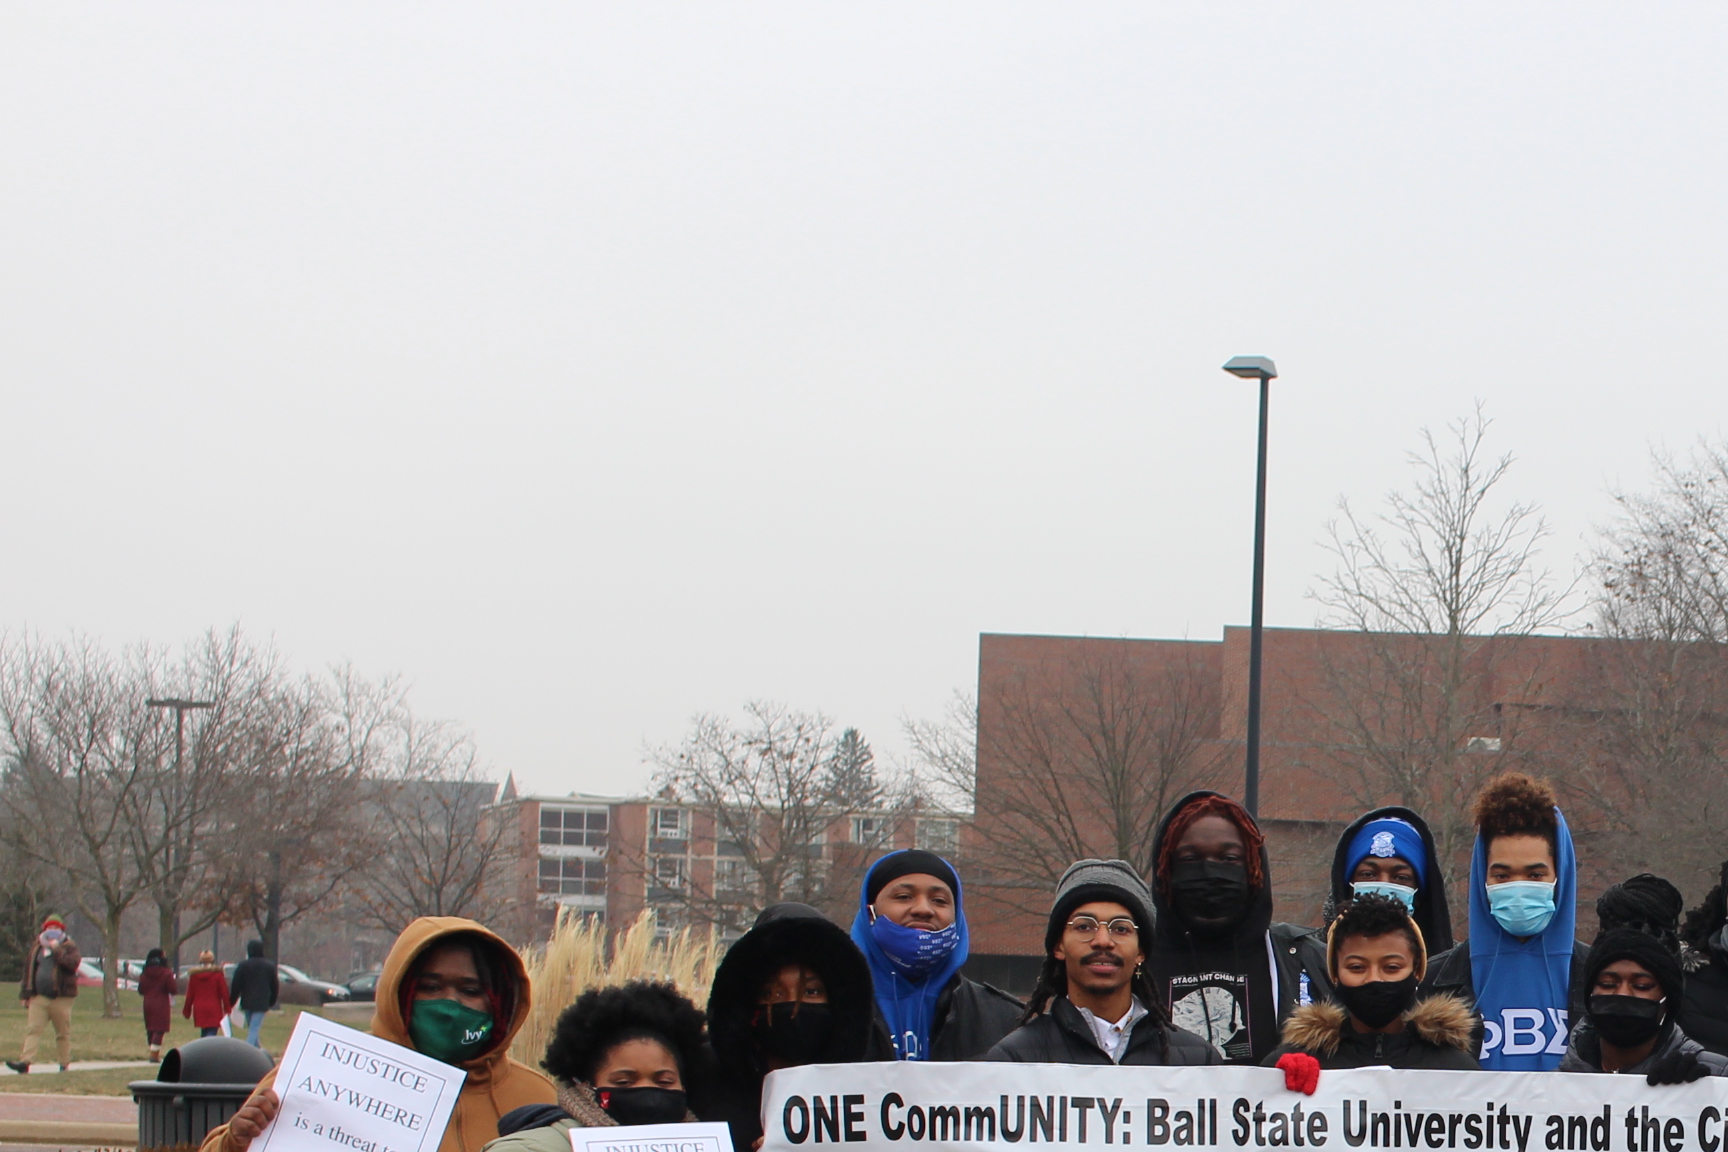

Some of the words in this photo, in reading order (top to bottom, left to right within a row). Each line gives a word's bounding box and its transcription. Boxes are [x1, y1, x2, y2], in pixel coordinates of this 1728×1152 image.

[465, 1030, 482, 1041] Ivy
[320, 1042, 428, 1094] INJUSTICE
[294, 1112, 309, 1129] is
[314, 1123, 323, 1135] a
[298, 1075, 423, 1131] ANYWHERE
[783, 1094, 866, 1144] ONE
[881, 1092, 1131, 1145] CommUNITY:
[1147, 1098, 1217, 1146] Ball
[1232, 1098, 1328, 1148] State
[1545, 1105, 1610, 1152] and
